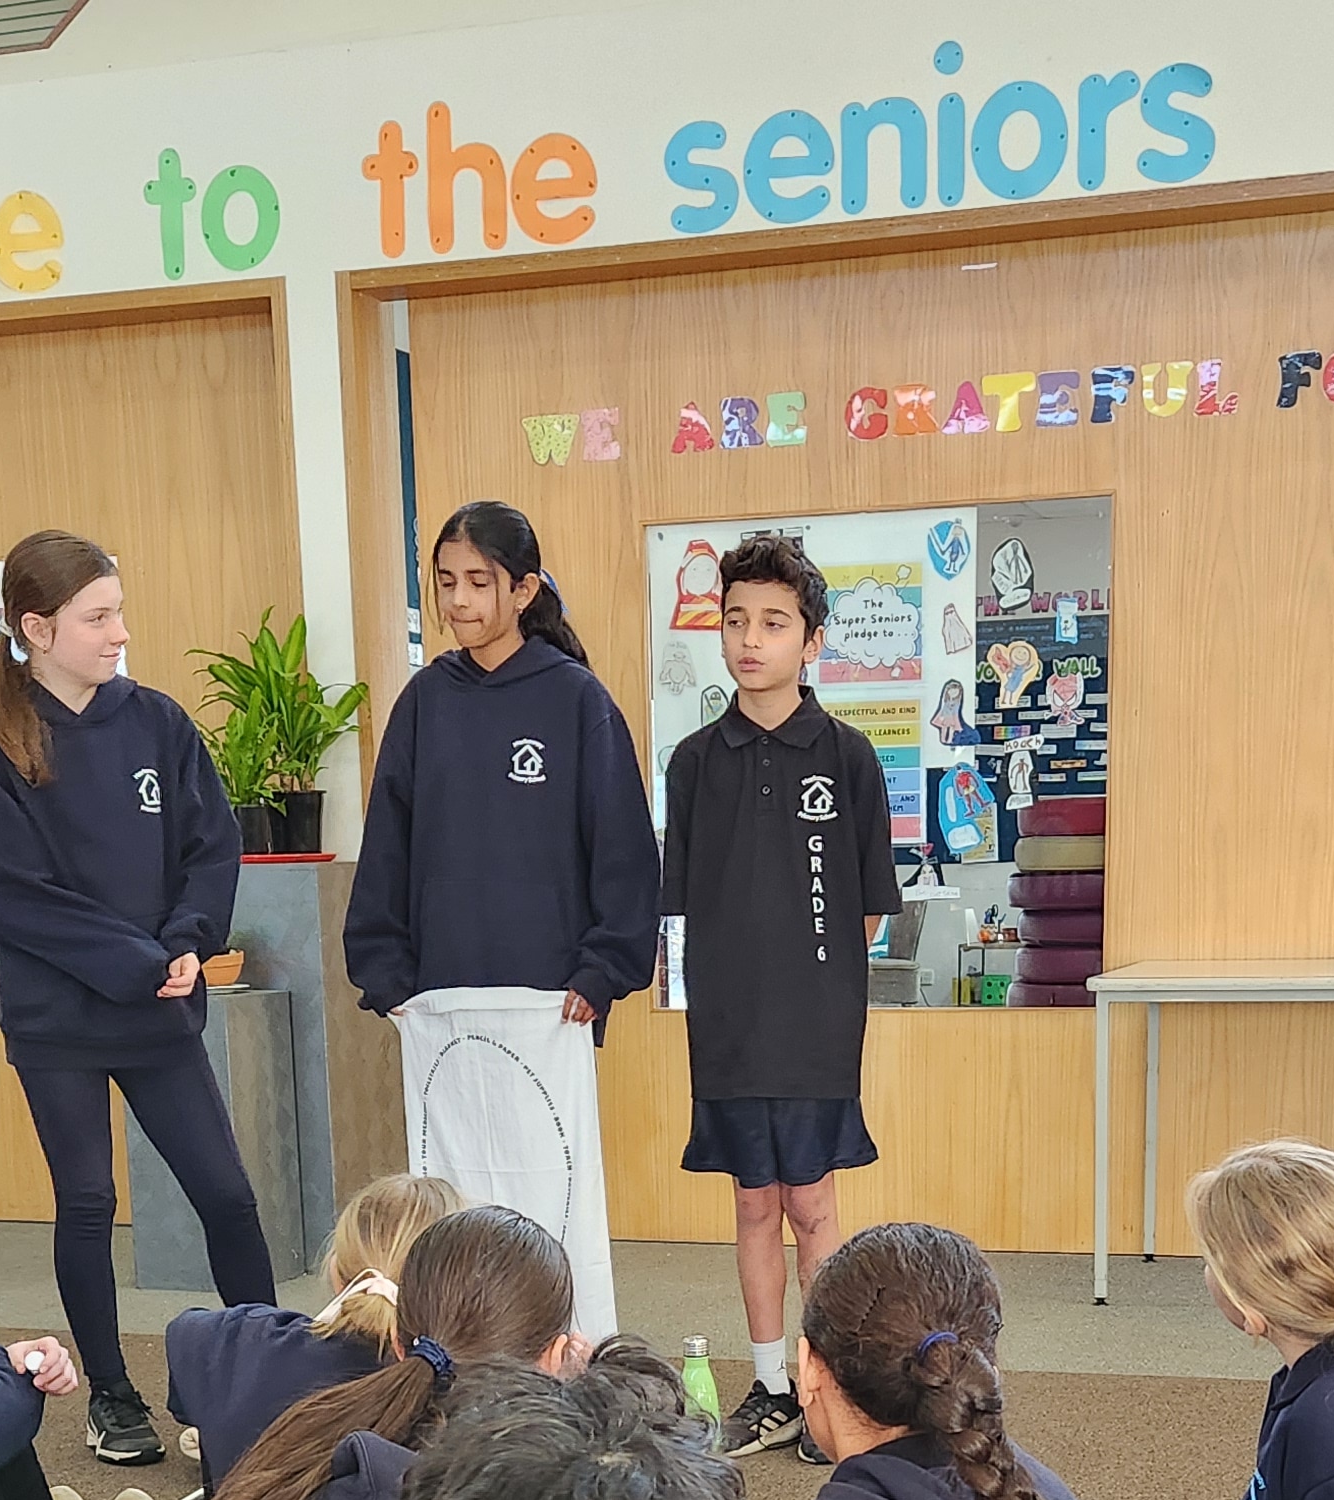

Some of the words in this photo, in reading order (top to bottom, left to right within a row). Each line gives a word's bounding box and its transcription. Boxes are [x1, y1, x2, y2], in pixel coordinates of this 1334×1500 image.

[143, 148, 281, 281] to
[361, 101, 598, 258] the
[664, 41, 1216, 233] seniors
[521, 405, 621, 467] WE
[671, 391, 808, 454] ARE
[845, 358, 1239, 441] GRATEFUL
[862, 600, 883, 609] The
[834, 615, 866, 627] Super
[870, 613, 913, 624] Seniors
[844, 630, 878, 641] pledge
[883, 630, 894, 638] to
[1053, 655, 1102, 678] WALL
[834, 708, 878, 716] RESPECTFUL
[881, 707, 896, 715] AND
[899, 706, 916, 714] KIND
[874, 728, 911, 736] LEARNERS
[807, 835, 826, 934] GRADE
[817, 945, 827, 962] 6
